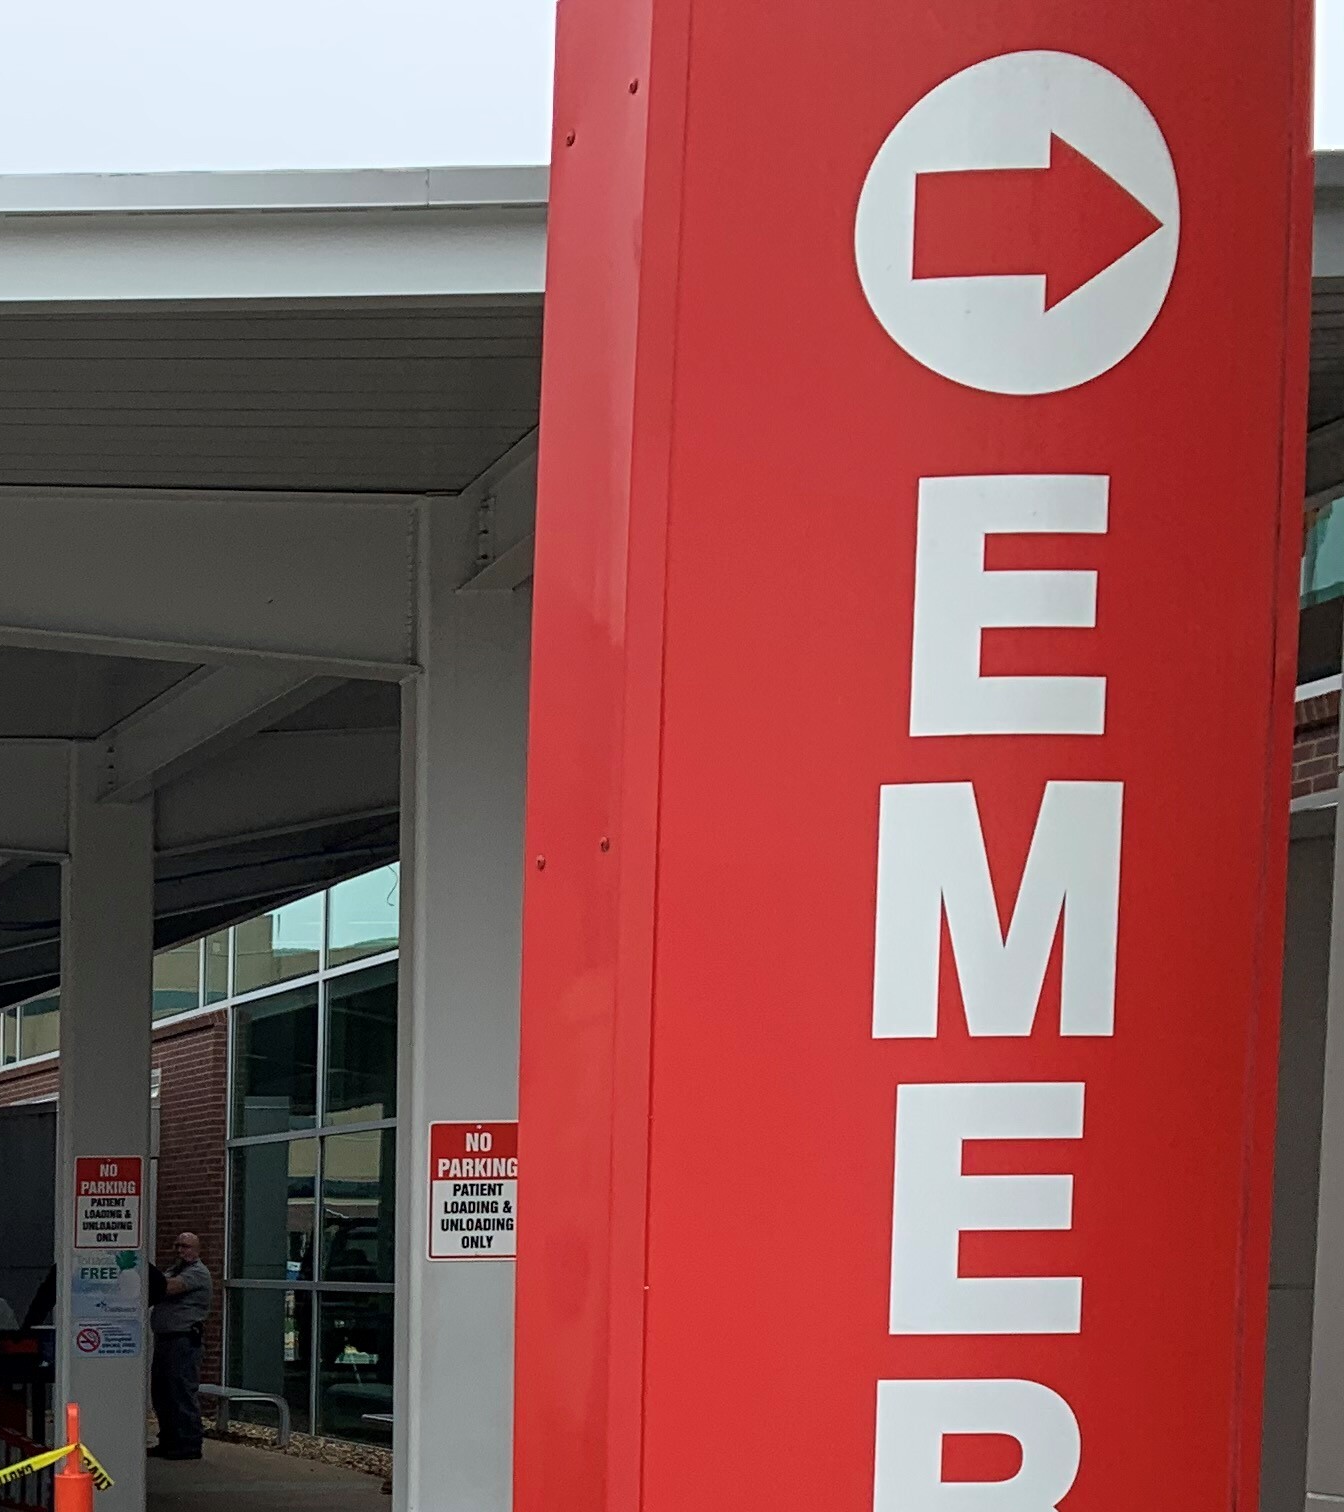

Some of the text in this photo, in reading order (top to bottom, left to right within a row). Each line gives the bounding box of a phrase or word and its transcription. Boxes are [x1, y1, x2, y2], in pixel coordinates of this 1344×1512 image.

[465, 1132, 492, 1152] NO
[99, 1164, 118, 1177] NO
[438, 1157, 518, 1178] PARKING
[81, 1181, 136, 1194] PARKING
[453, 1183, 504, 1197] PATIENT
[91, 1198, 126, 1207] PATIENT
[444, 1200, 512, 1214] LOADING &
[84, 1210, 122, 1219] LOADING
[440, 1218, 514, 1231] UNLOADING
[96, 1233, 118, 1242] ONLY
[461, 1235, 493, 1249] ONLY
[80, 1268, 118, 1280] FREE
